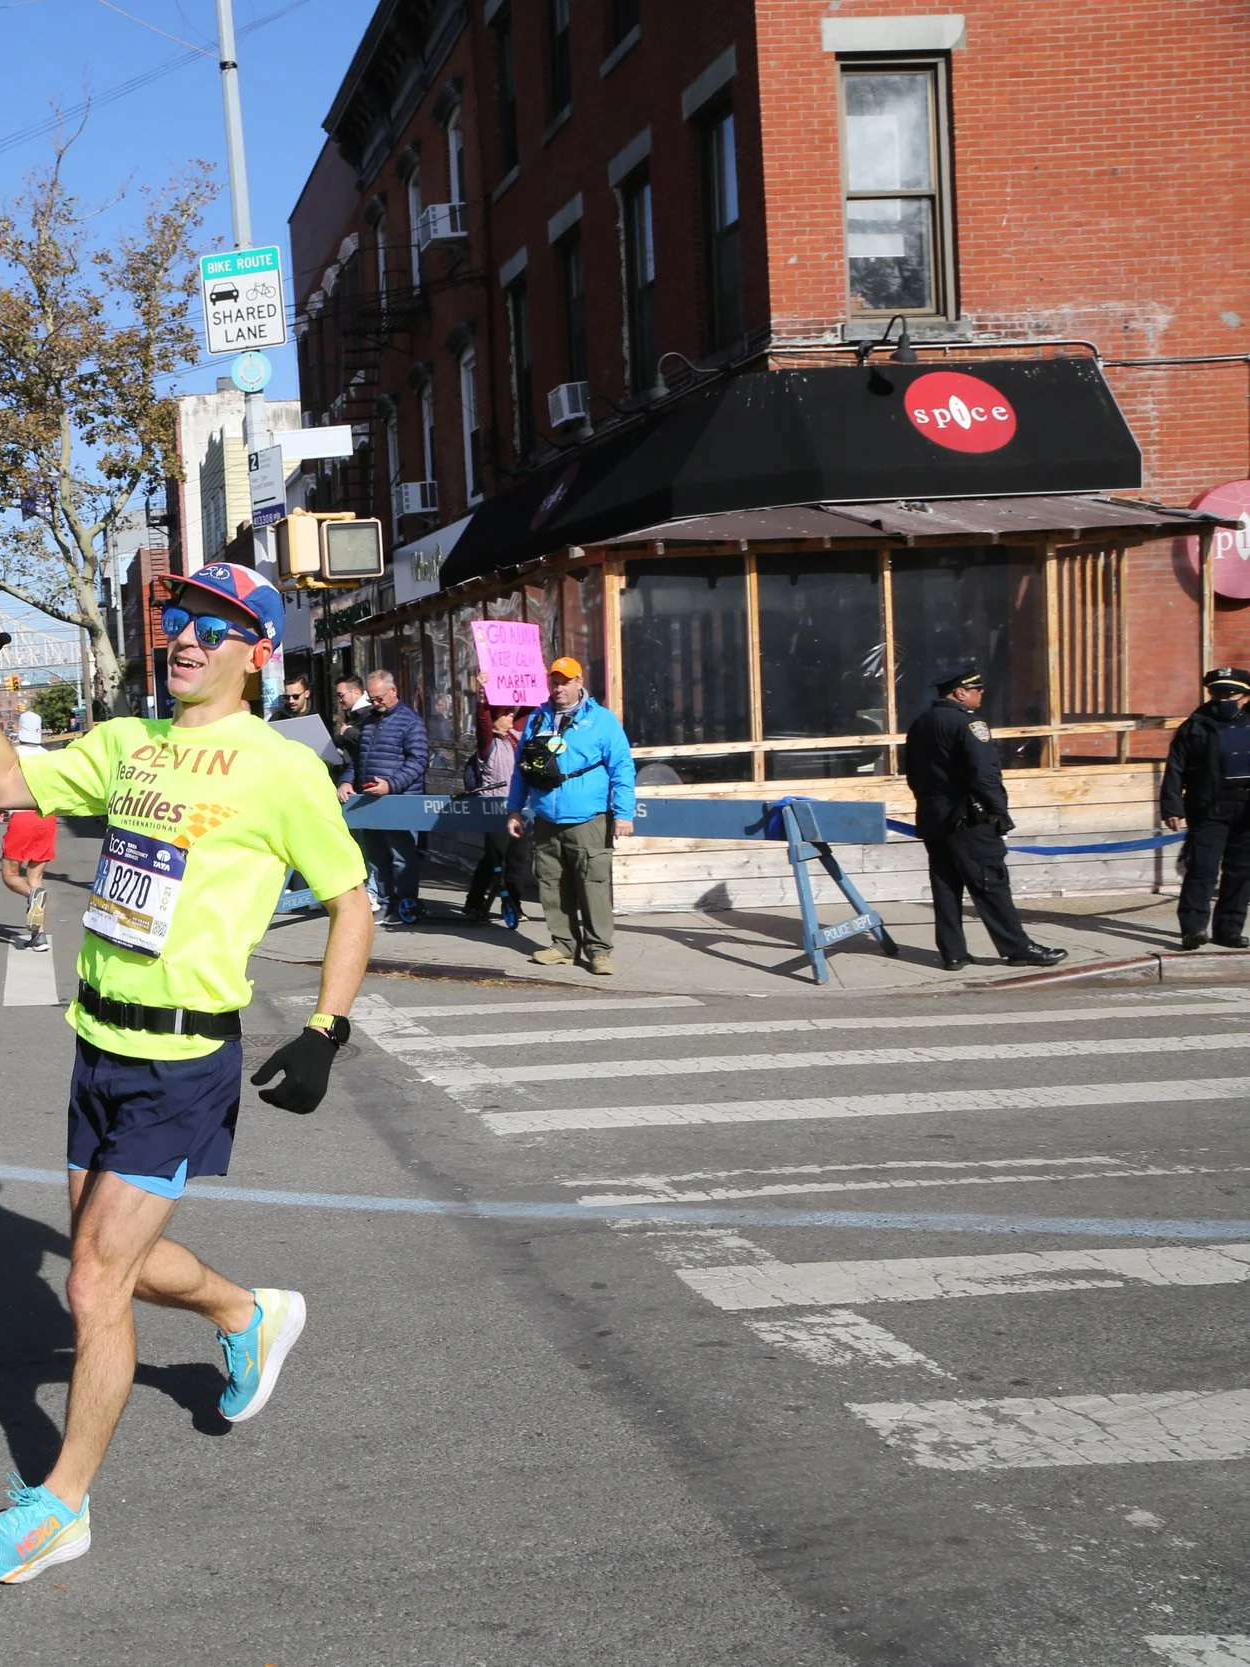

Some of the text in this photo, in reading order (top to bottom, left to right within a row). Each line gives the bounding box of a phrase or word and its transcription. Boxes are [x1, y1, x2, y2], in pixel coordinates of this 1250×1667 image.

[207, 253, 273, 274] BIKE ROUTE
[212, 303, 277, 325] SHARED
[224, 324, 268, 343] LANE
[913, 401, 1009, 429] spice
[487, 624, 506, 644] GO
[513, 690, 526, 703] ON
[131, 743, 239, 776] DEVIN
[115, 760, 158, 784] Team
[107, 787, 187, 823] Achilles
[424, 800, 470, 815] POLICE
[121, 818, 178, 833] INTERNATIONAL
[152, 860, 171, 872] TATA
[109, 865, 152, 909] 8270
[160, 886, 172, 912] 2021
[823, 922, 851, 942] POLICE
[15, 1515, 60, 1560] HOKA
